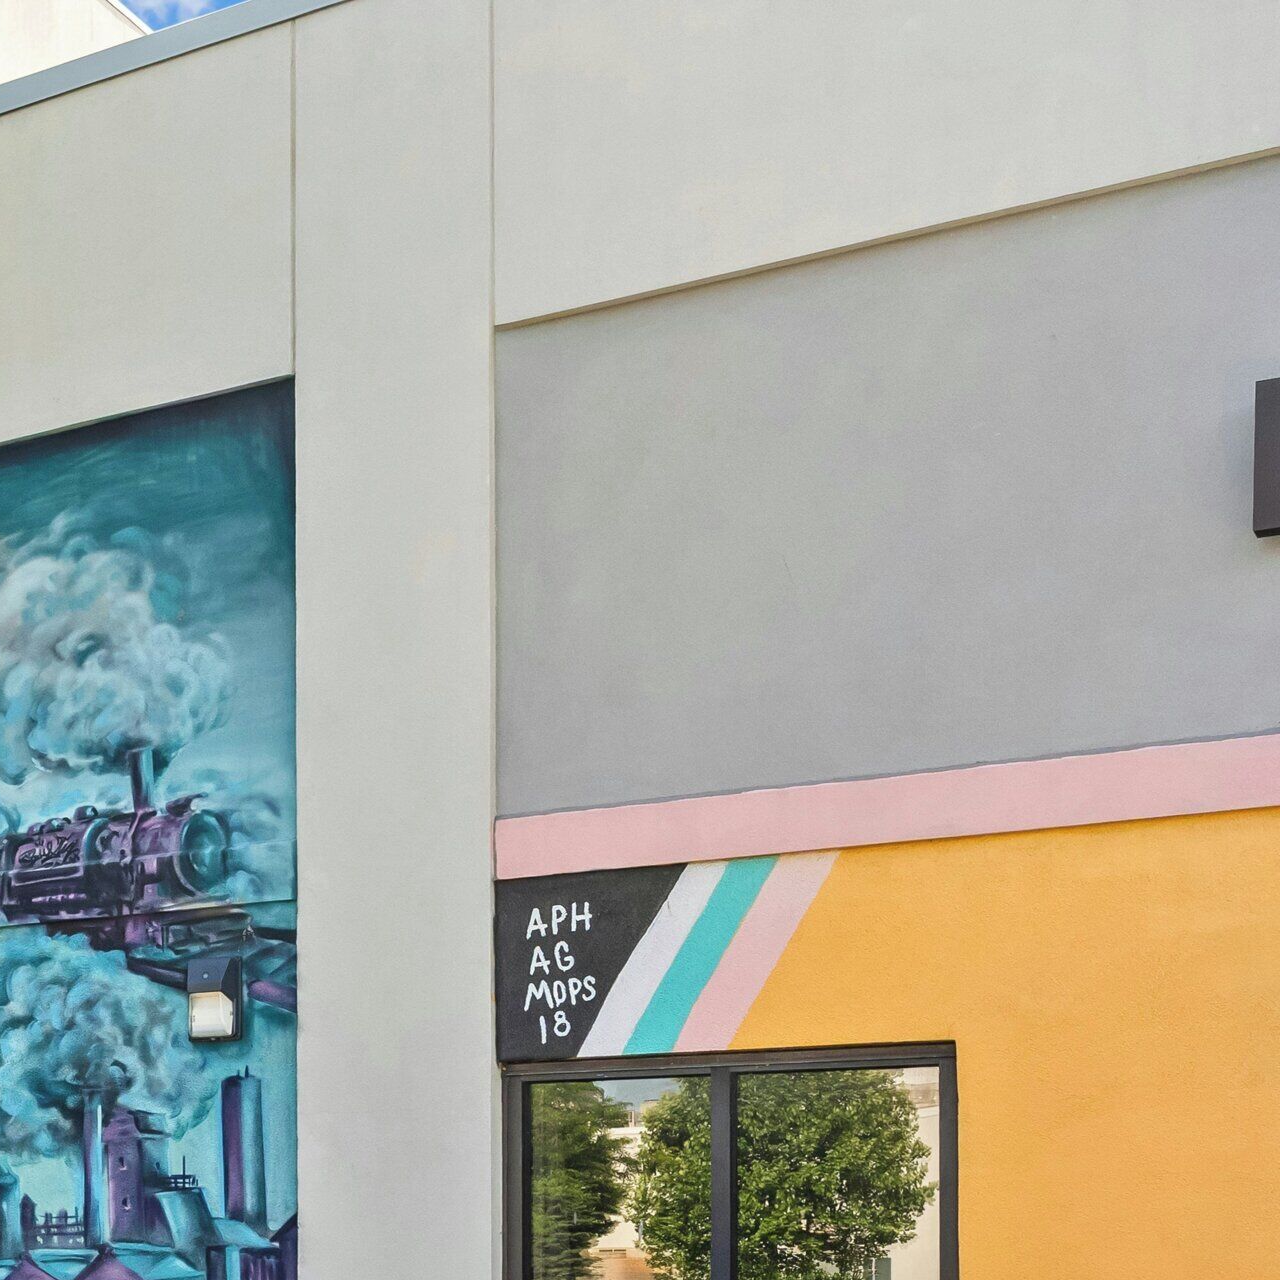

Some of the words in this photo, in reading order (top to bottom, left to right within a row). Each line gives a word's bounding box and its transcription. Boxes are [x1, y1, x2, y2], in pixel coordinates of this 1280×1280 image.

[526, 901, 592, 940] APH
[523, 975, 596, 1012] MOPS
[539, 1010, 571, 1044] 18
